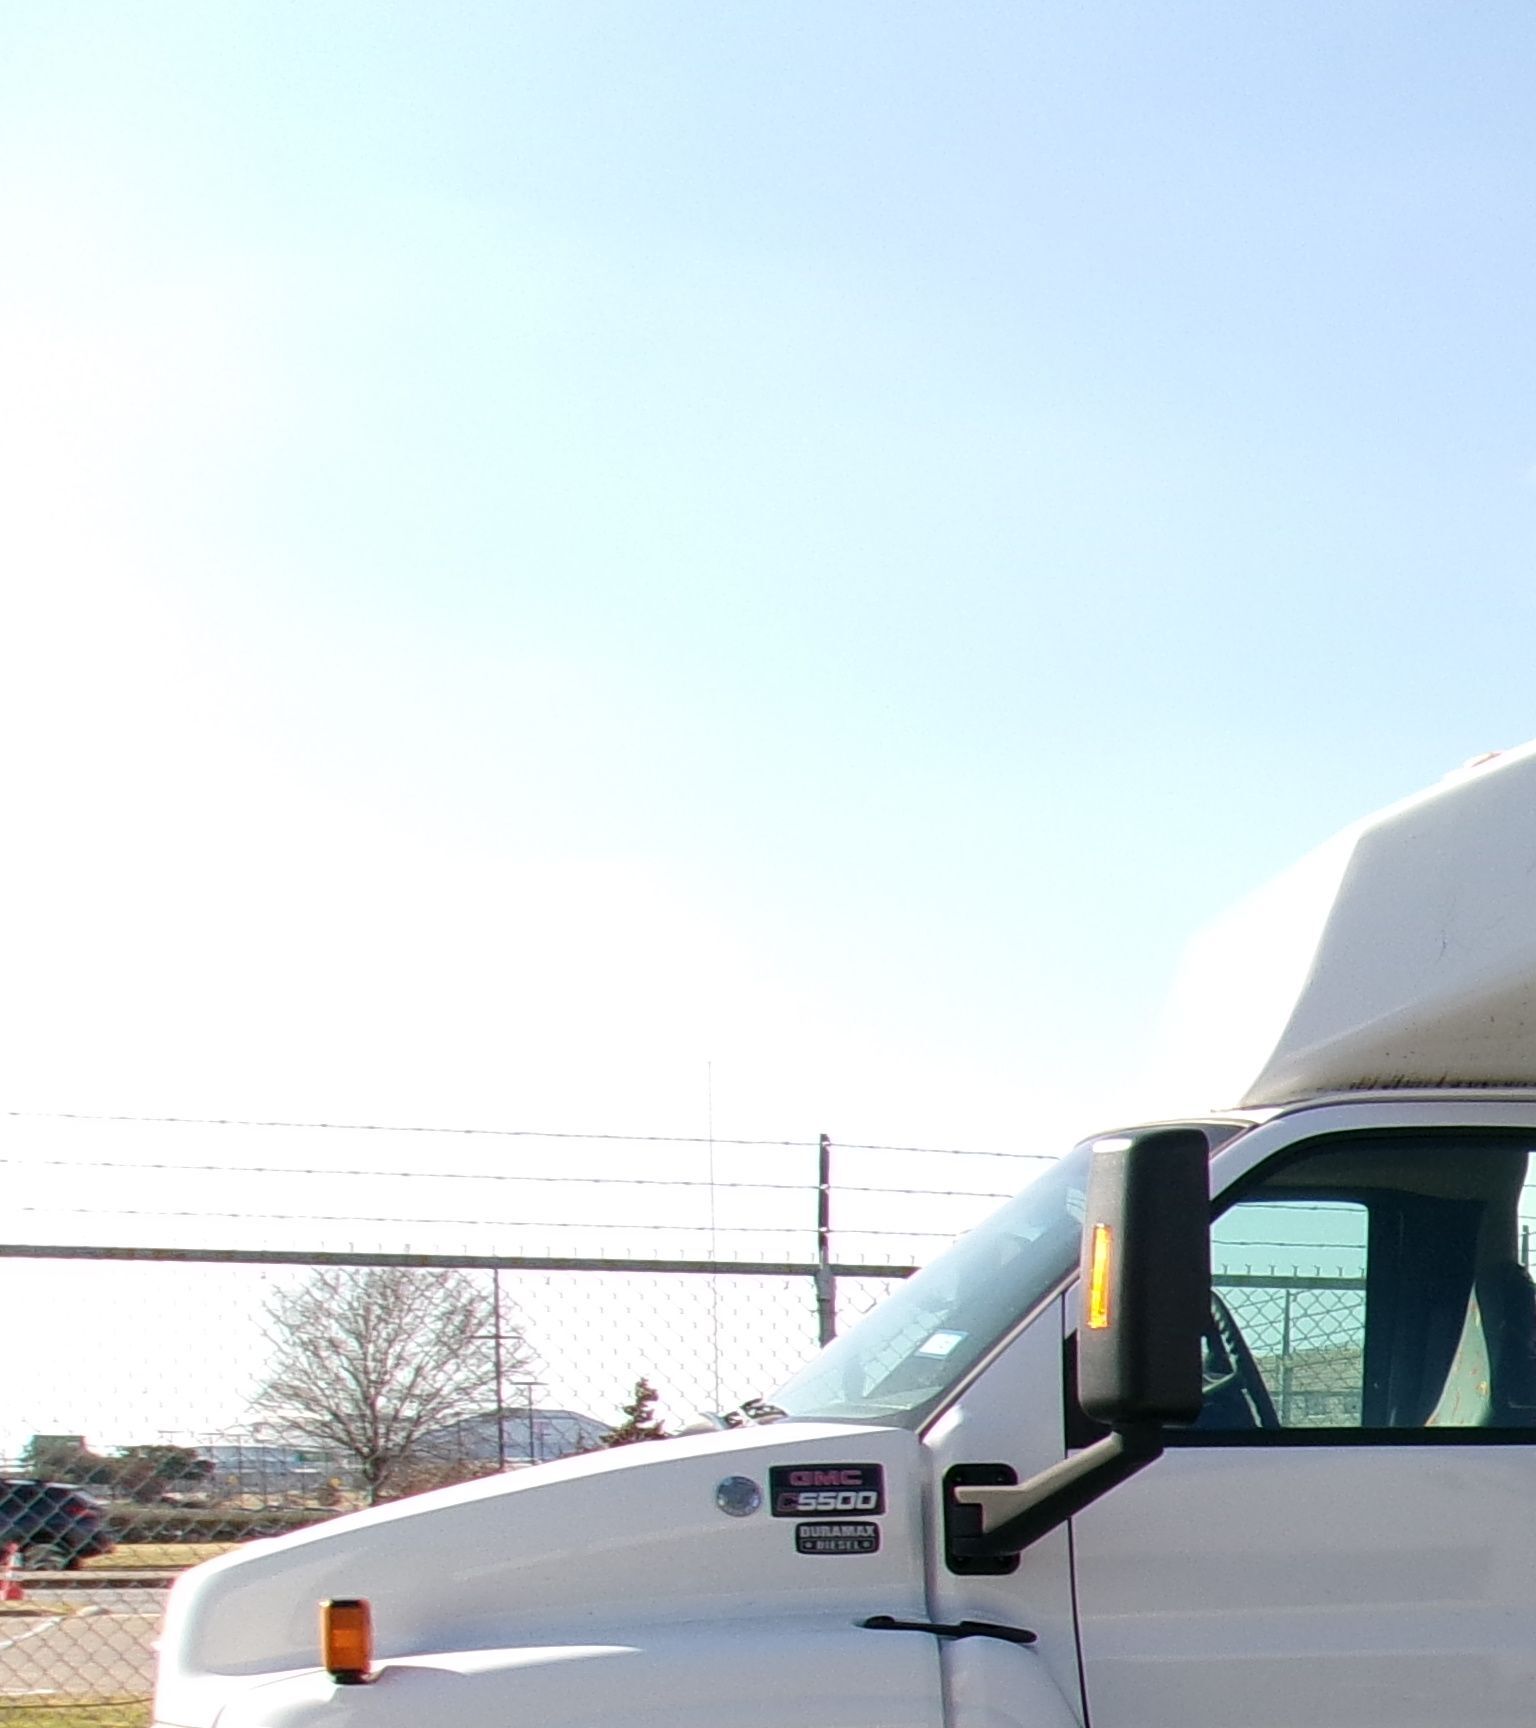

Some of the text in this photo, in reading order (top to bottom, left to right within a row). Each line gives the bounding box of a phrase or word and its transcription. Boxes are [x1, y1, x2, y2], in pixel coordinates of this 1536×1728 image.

[790, 1470, 863, 1486] GMC
[777, 1491, 878, 1512] C5500
[800, 1525, 875, 1538] DURAMAX
[816, 1541, 860, 1550] DIESEL
